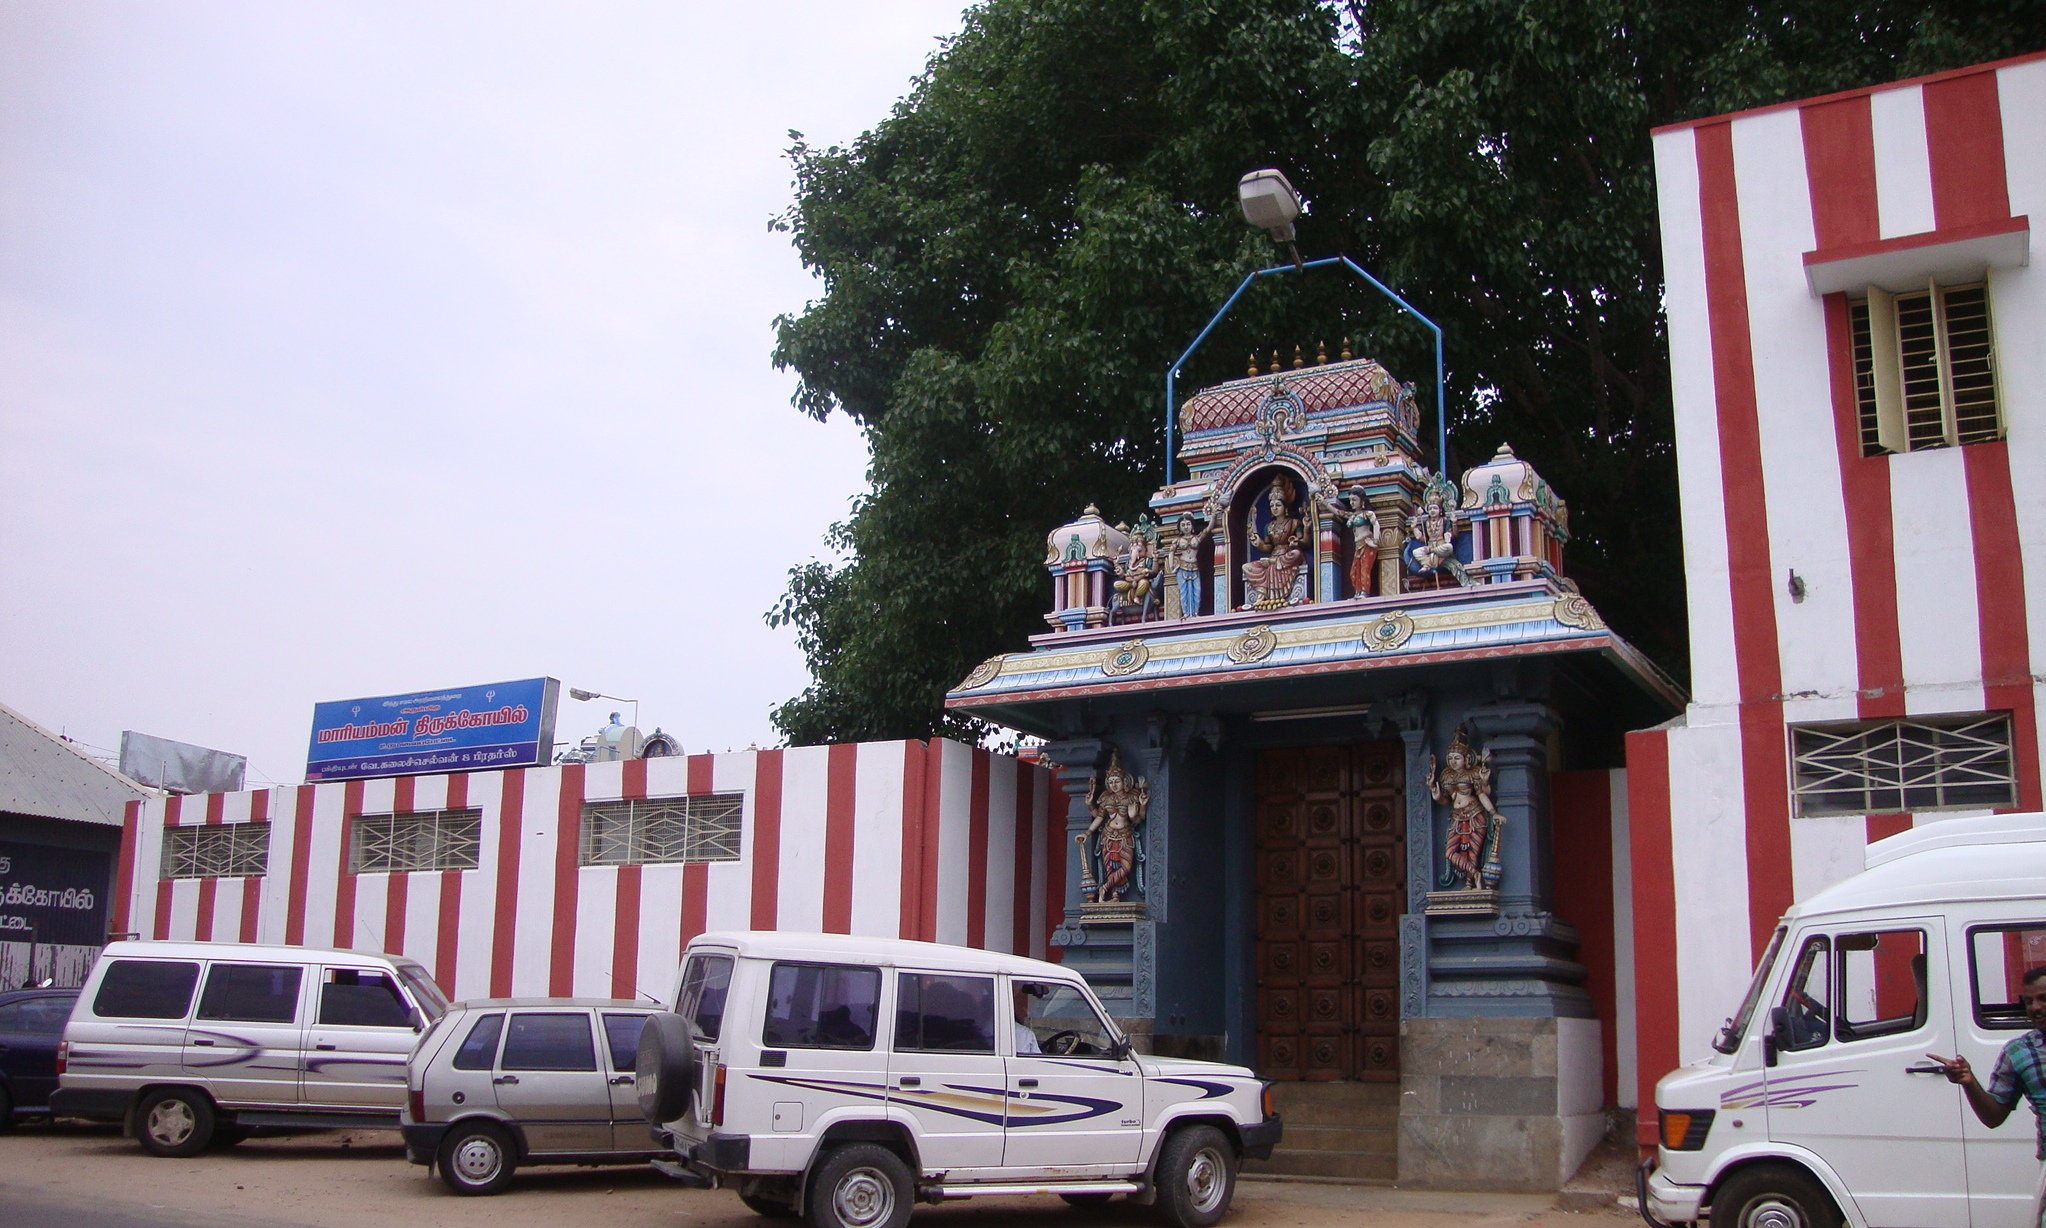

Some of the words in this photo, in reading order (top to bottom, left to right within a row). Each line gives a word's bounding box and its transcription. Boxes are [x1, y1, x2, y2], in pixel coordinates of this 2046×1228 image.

[317, 717, 409, 744] மாரியம்மன்
[412, 705, 529, 740] திருக்கோயில்
[473, 747, 518, 763] பிரதர்ஸ்
[0, 882, 94, 910] க்கோயில்
